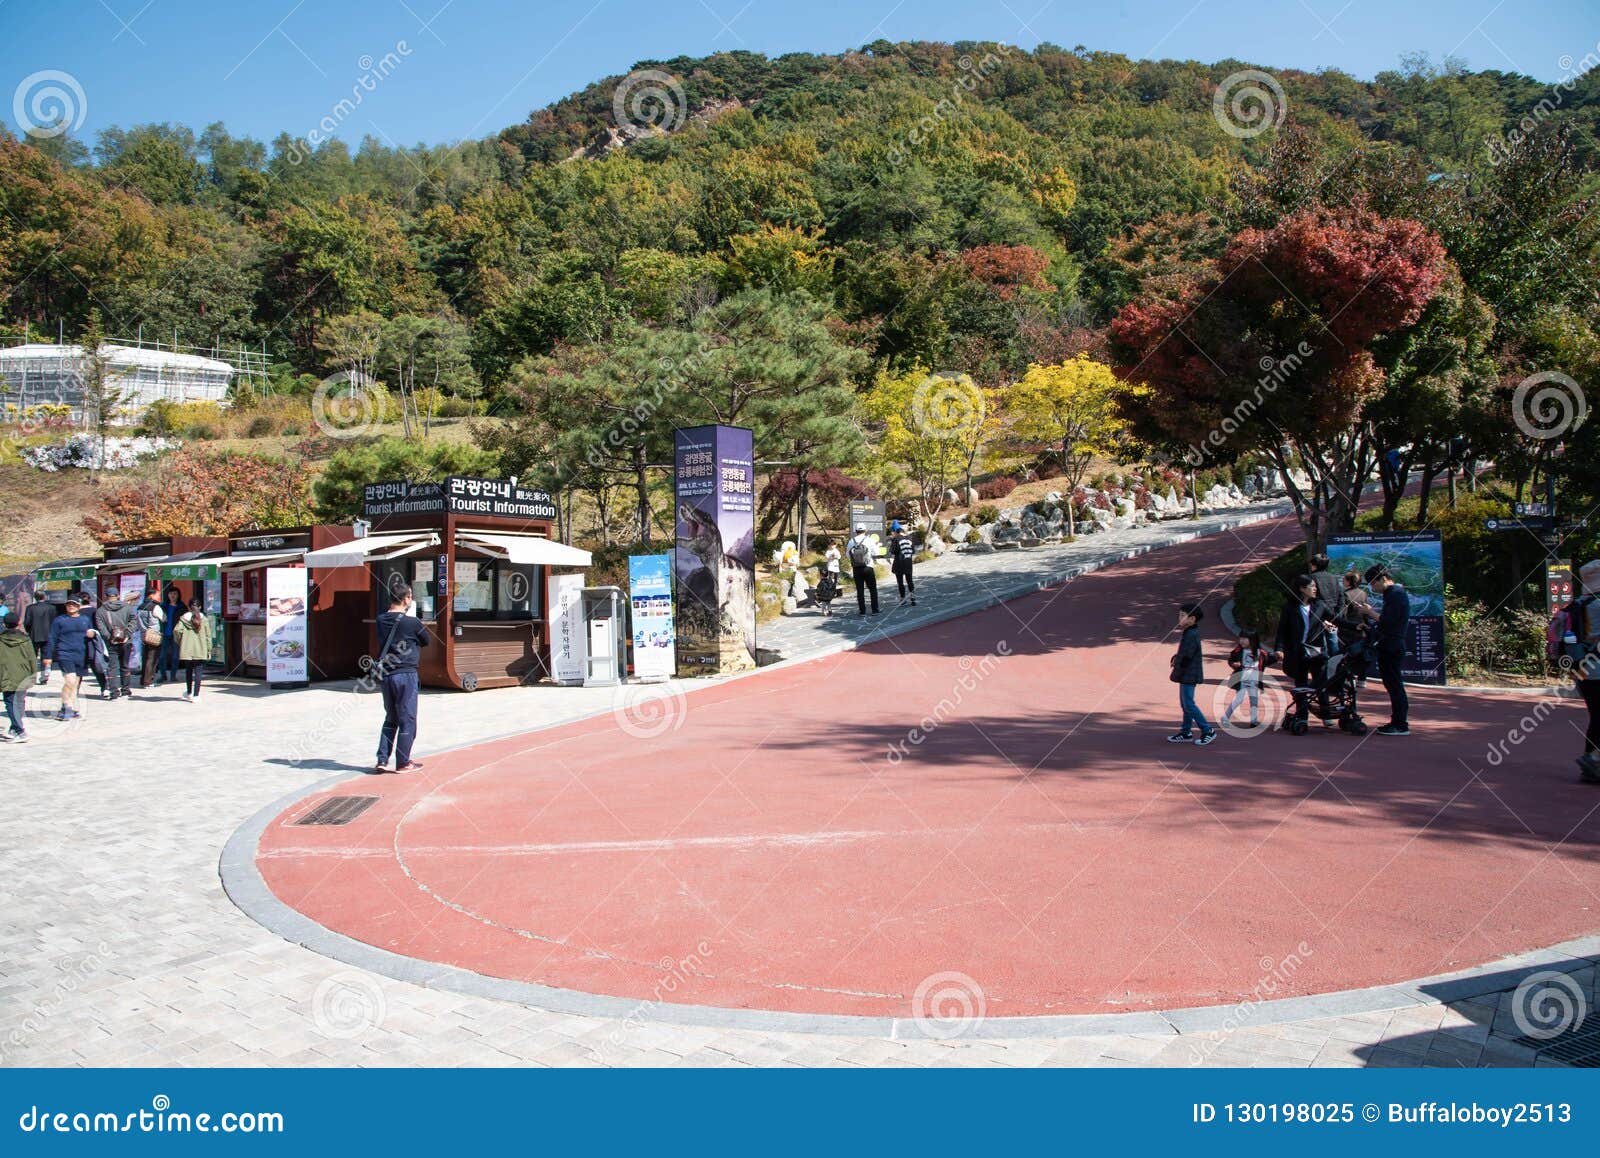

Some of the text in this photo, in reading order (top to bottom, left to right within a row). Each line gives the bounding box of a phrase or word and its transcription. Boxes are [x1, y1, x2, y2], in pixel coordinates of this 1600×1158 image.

[365, 482, 407, 500] 관광안내
[451, 478, 510, 498] 관광안내
[365, 499, 443, 515] Tourist Information
[451, 497, 555, 517] Tourist Information
